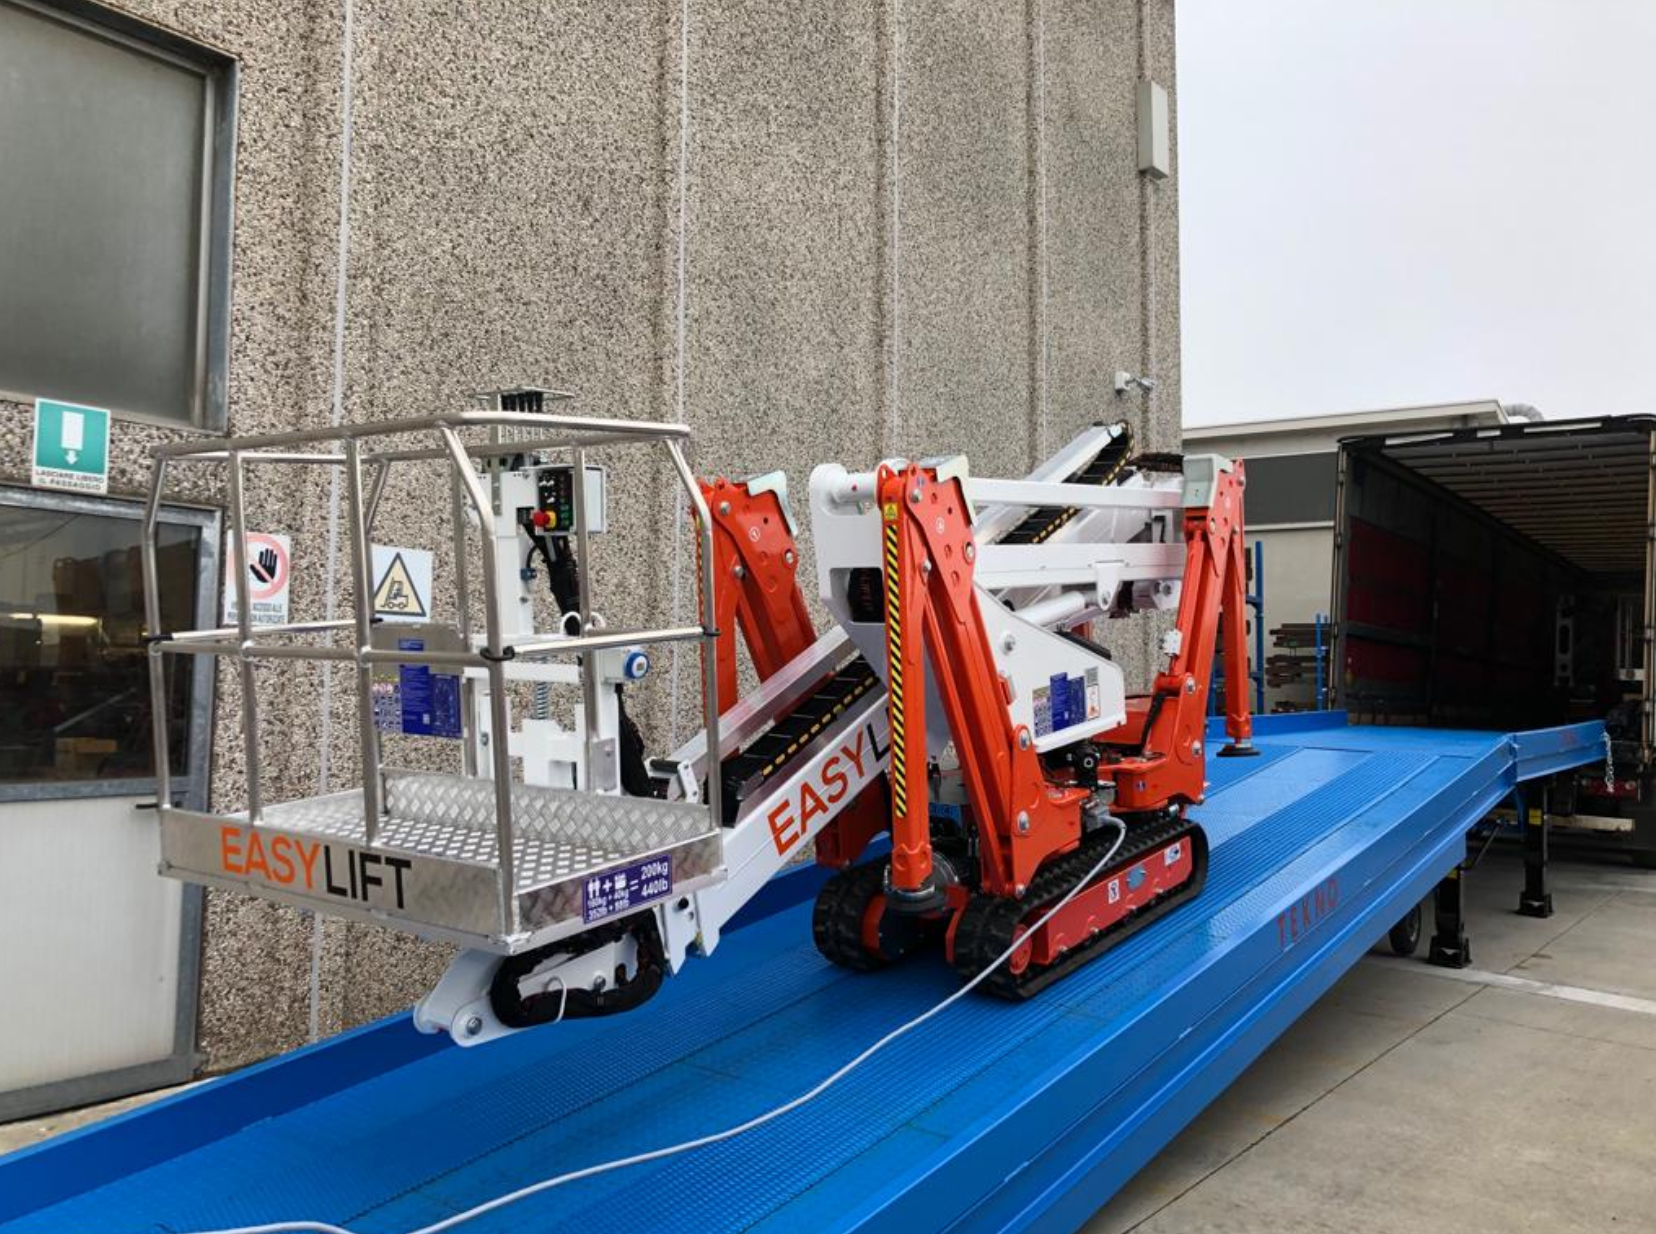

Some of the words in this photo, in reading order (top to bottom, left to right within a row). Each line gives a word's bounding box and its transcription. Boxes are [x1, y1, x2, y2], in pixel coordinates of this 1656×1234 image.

[35, 469, 74, 479] LASCIARE
[75, 474, 105, 484] LIBERO
[50, 478, 101, 491] PASSAGGIO
[767, 709, 891, 857] EASYL
[220, 825, 412, 910] EASYLIFT
[641, 861, 669, 880] 200kg
[641, 878, 669, 897] 440lb
[1276, 879, 1338, 950] TEKNO
